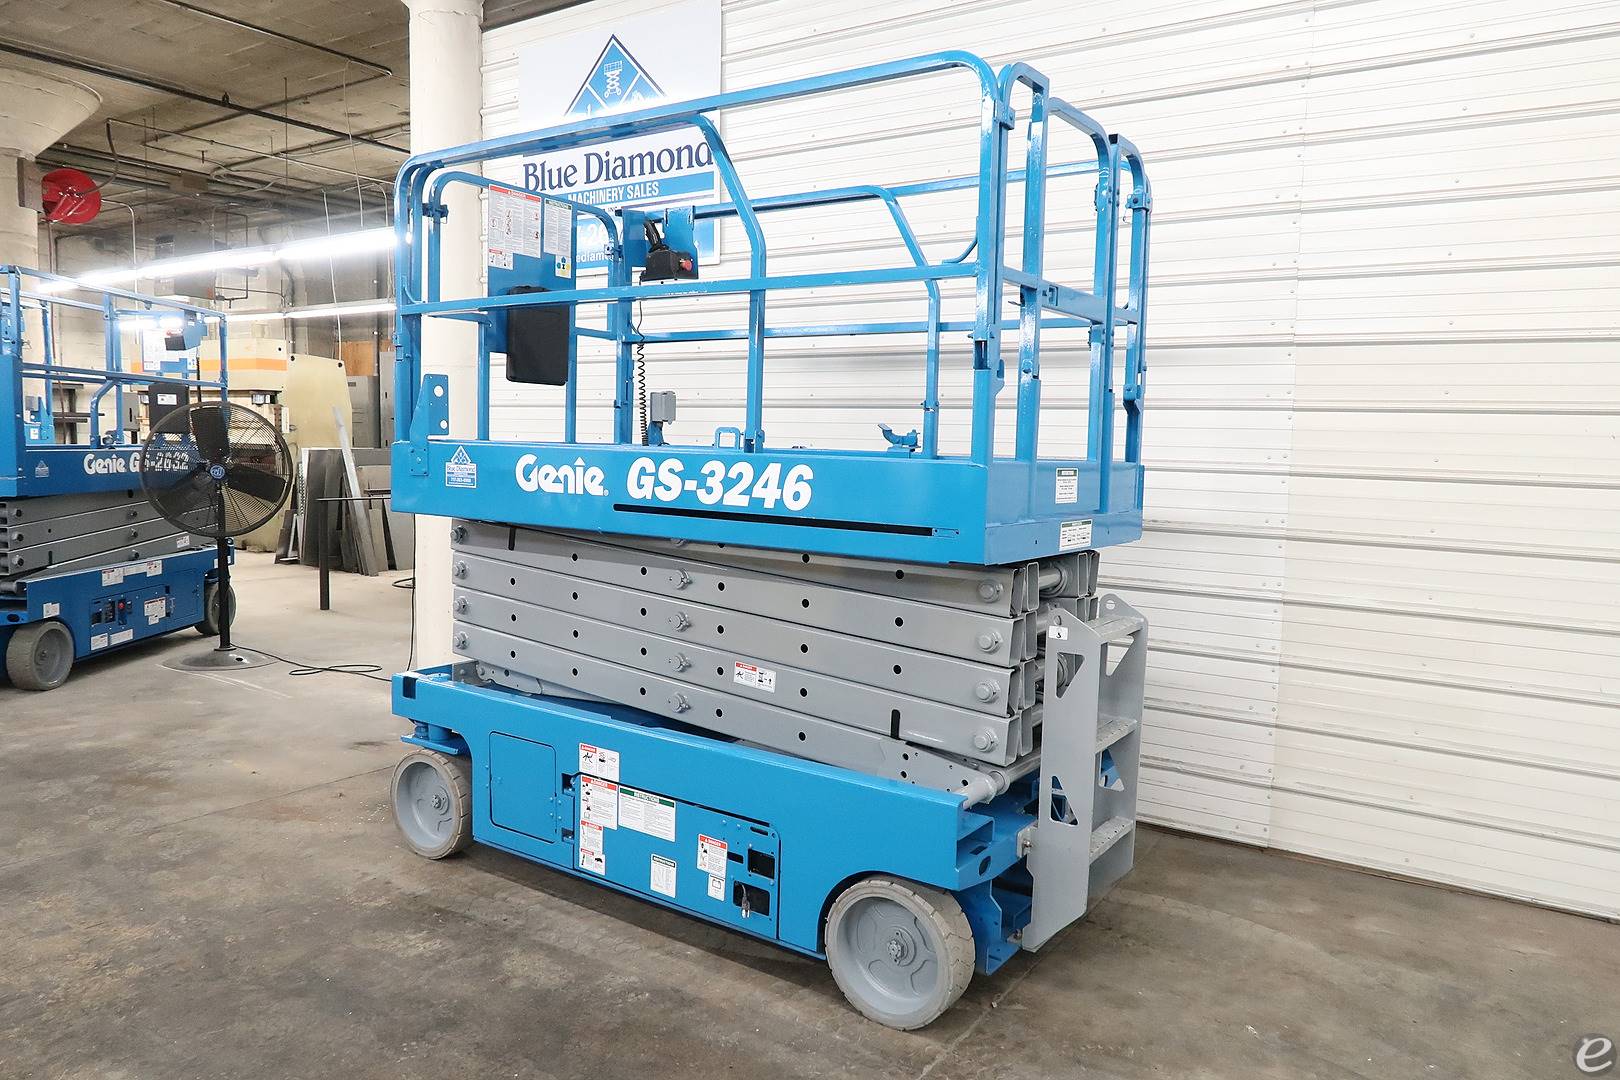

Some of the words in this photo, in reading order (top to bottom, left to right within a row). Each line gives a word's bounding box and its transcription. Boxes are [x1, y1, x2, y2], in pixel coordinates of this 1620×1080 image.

[523, 160, 578, 192] Blue
[584, 141, 714, 185] Diamond
[568, 186, 625, 204] MACHINERY
[627, 182, 660, 198] SALES
[84, 453, 126, 475] Genie
[515, 453, 606, 496] Genie
[626, 456, 815, 511] GS-3246
